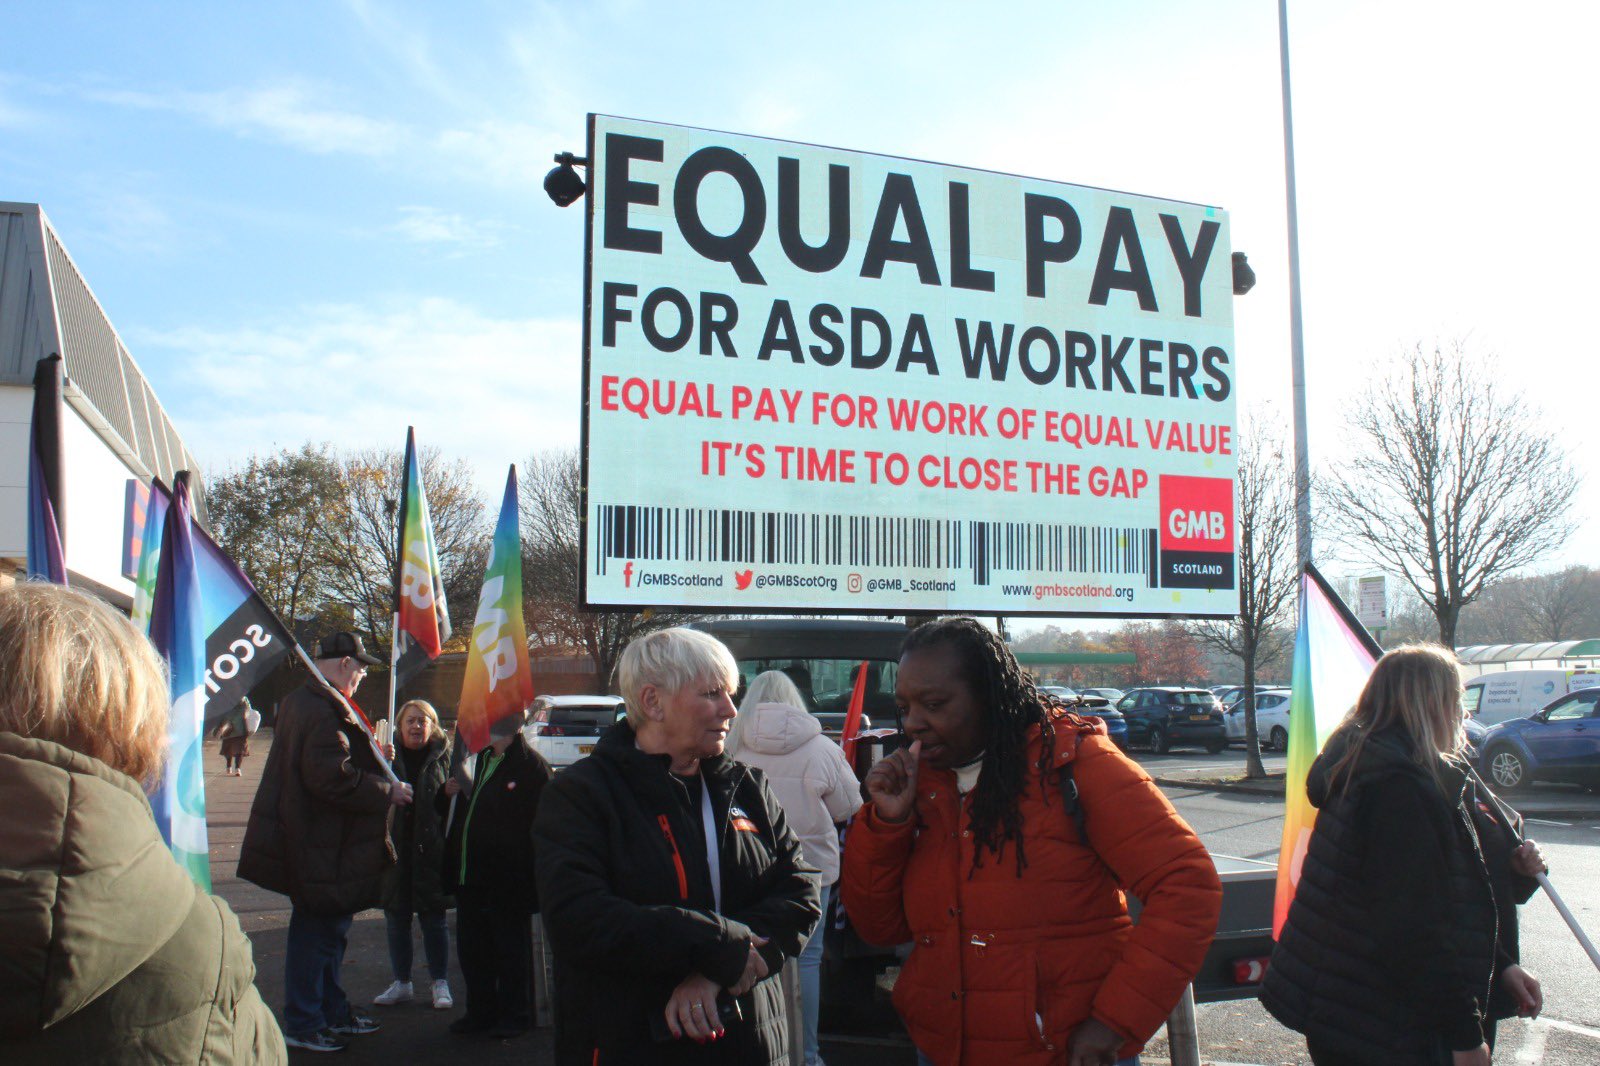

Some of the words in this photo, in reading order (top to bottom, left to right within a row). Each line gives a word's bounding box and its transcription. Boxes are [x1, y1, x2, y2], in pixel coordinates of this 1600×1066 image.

[604, 132, 995, 292] EQUAL
[1024, 192, 1221, 317] PAY
[602, 281, 739, 358] FOR
[757, 298, 940, 376] ASDA
[955, 317, 1231, 402] WORKERS
[601, 375, 722, 419] EQUAL
[732, 385, 803, 424] PAY
[812, 391, 878, 429] FOR
[887, 397, 989, 437] WORK
[997, 406, 1037, 440] OF
[1045, 410, 1139, 449] EQUAL
[1145, 418, 1232, 455] VALUE
[701, 441, 766, 478] IT'S
[775, 445, 856, 483] TIME
[864, 450, 910, 486] TO
[918, 455, 1018, 492] CLOSE
[1026, 461, 1080, 496] THE
[1088, 465, 1149, 499] GAP
[1168, 508, 1226, 540] GMB
[637, 569, 723, 588] /GMBScotland
[1173, 563, 1223, 575] SCOTLAND
[755, 574, 838, 591] @GMBScotOrg
[866, 579, 956, 593] @GMB_Scotland
[1002, 582, 1134, 601] www.gmbscotland.org
